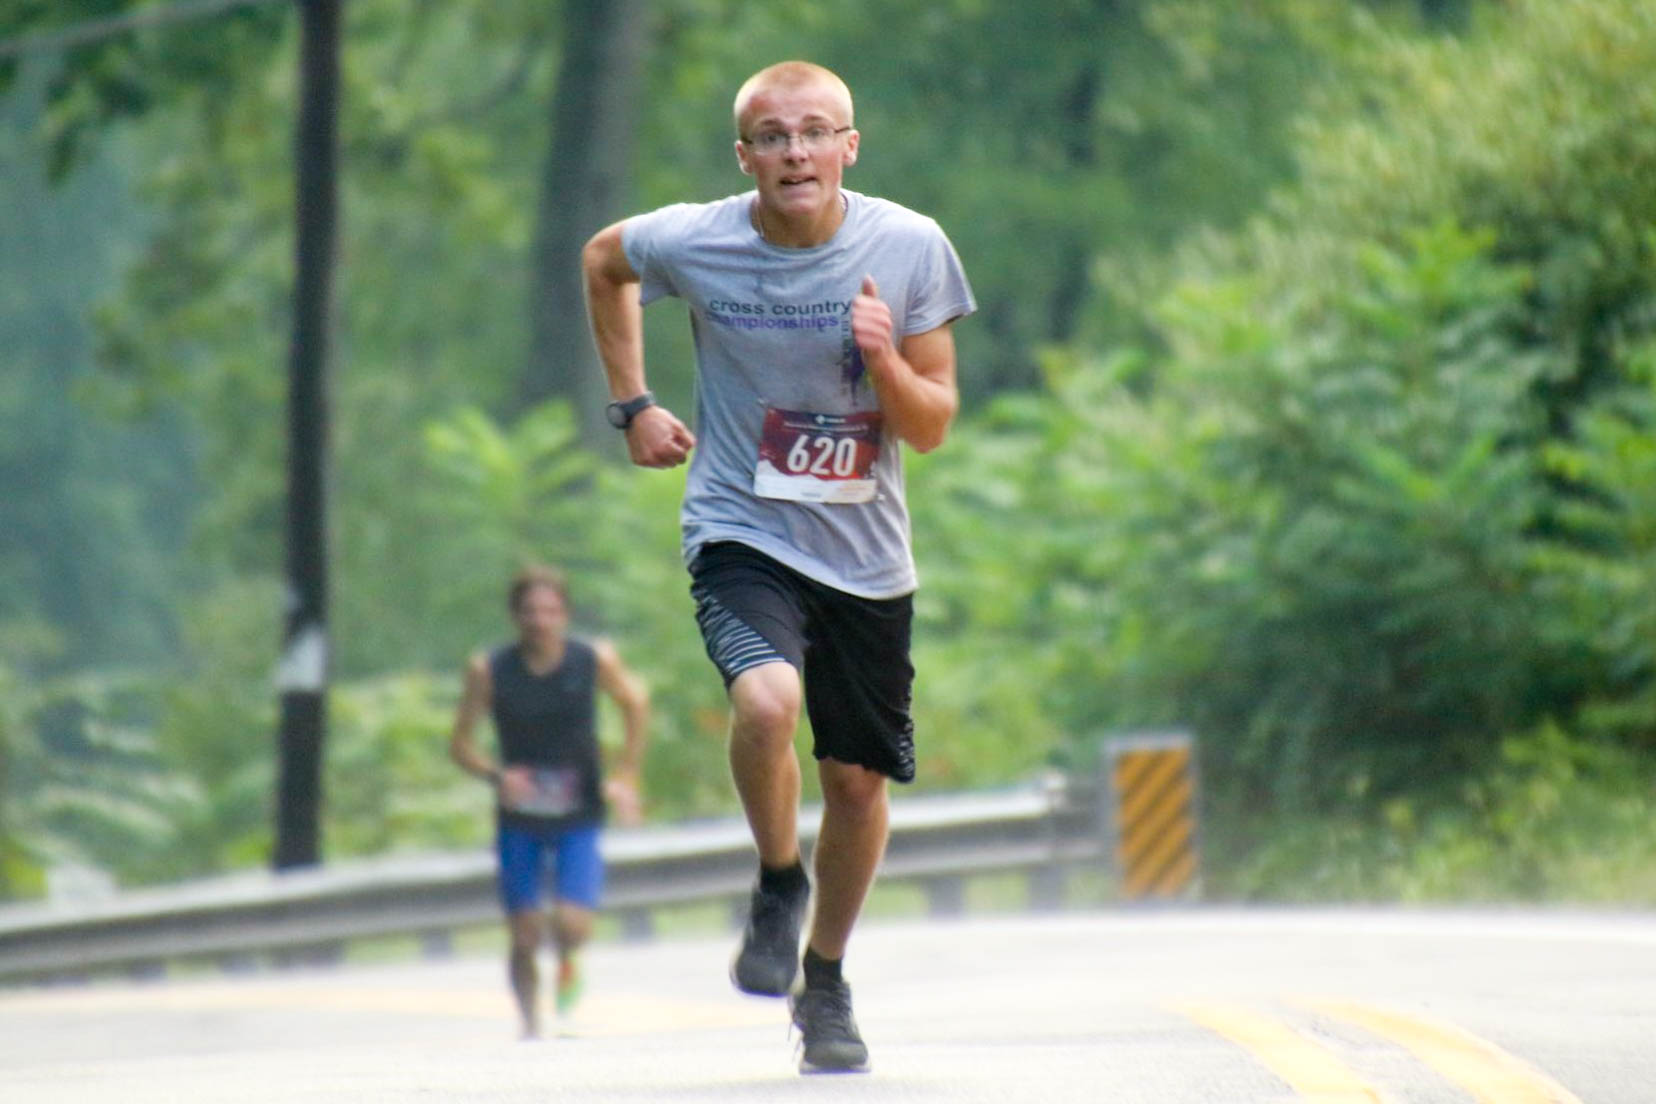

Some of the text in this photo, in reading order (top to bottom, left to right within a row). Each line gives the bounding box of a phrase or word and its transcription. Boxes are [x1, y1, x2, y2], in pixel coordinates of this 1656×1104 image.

[709, 299, 851, 316] cross country
[707, 312, 839, 332] ampionships
[787, 434, 858, 477] 620
